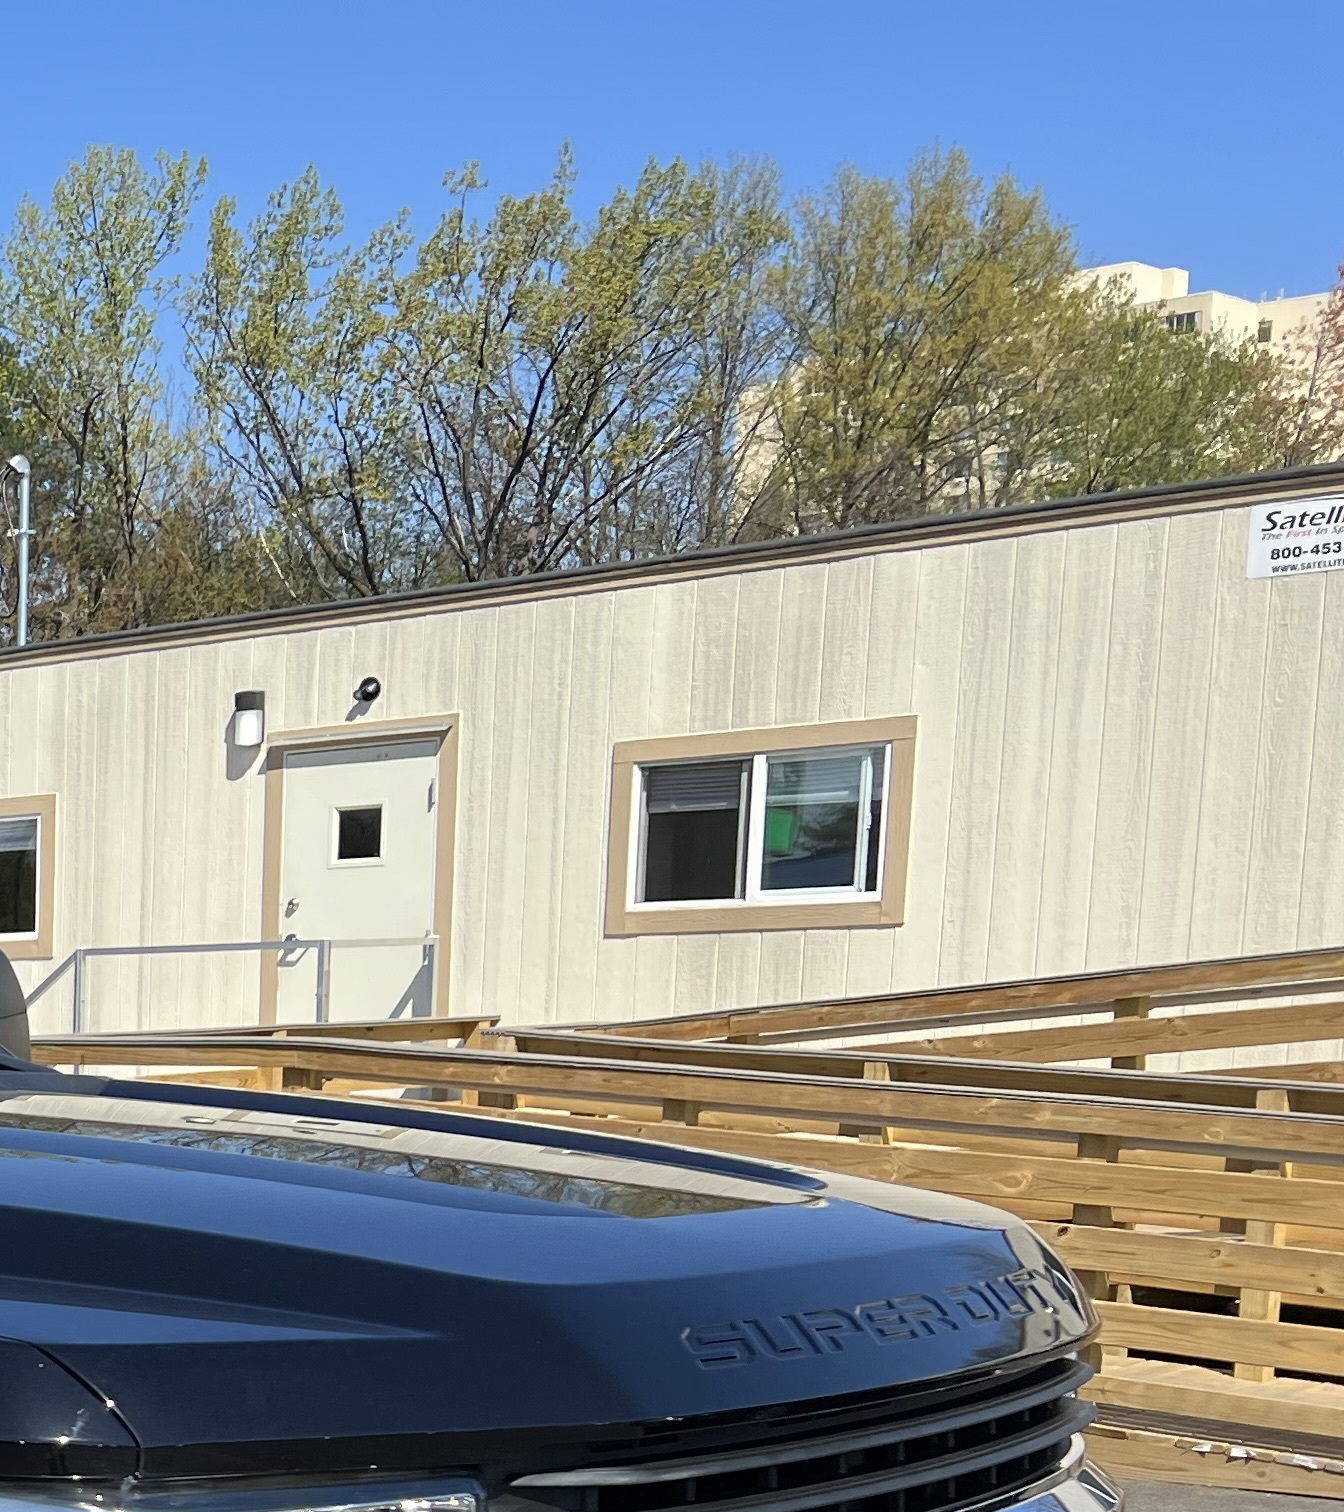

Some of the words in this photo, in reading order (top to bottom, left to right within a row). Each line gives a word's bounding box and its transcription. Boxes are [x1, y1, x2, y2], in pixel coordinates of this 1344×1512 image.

[1261, 505, 1344, 532] Satell
[1261, 533, 1283, 541] The
[1286, 529, 1312, 539] First
[1270, 541, 1342, 560] 800-453
[681, 1293, 961, 1371] SUPER
